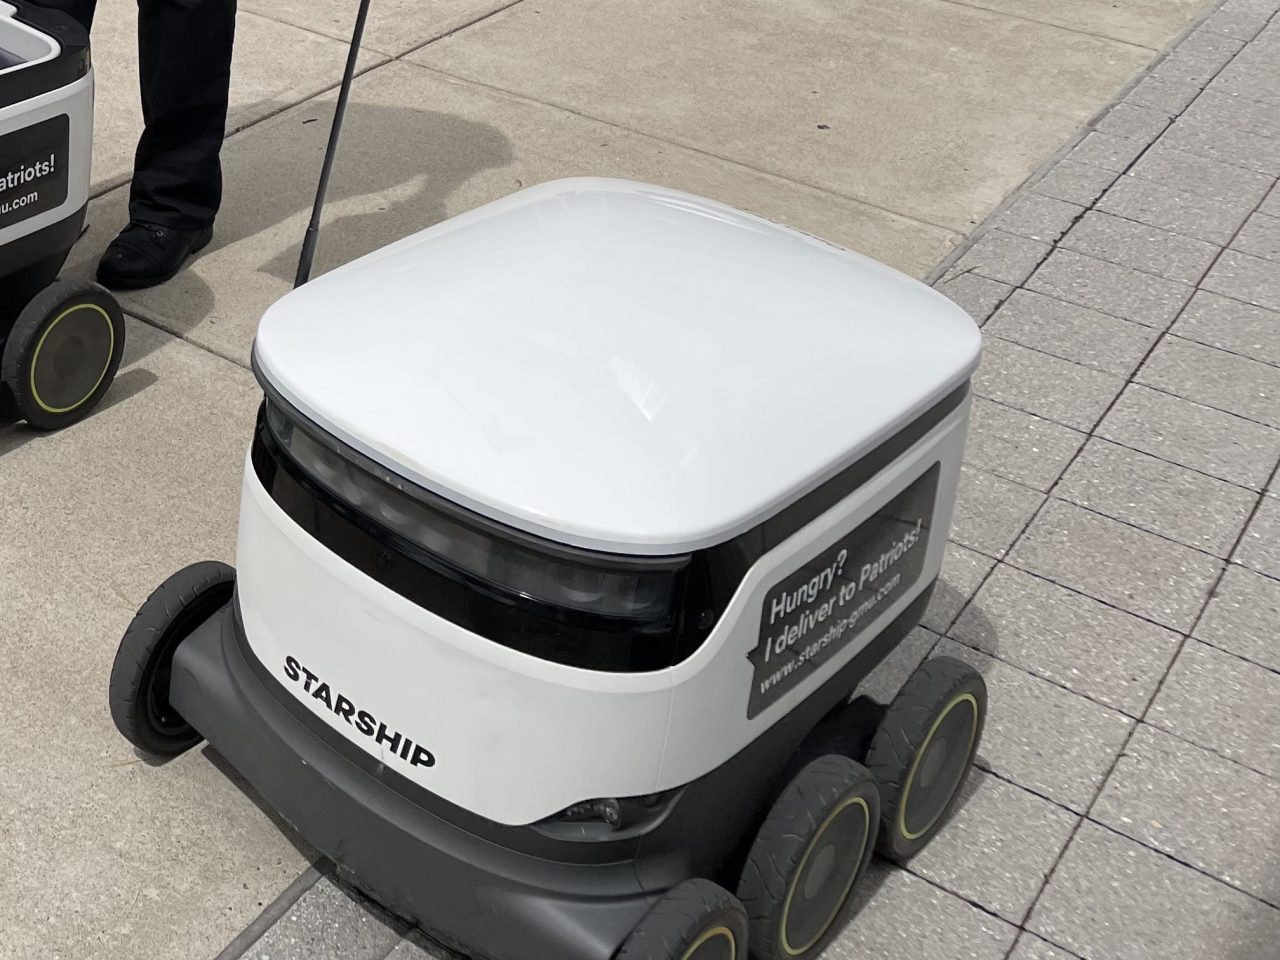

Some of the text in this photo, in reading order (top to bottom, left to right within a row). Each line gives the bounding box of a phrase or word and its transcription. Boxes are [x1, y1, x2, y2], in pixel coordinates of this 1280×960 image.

[761, 573, 901, 694] www.starship-gmu.com
[765, 518, 922, 662] I deliver to Patriots!
[770, 549, 848, 625] Hungry?
[284, 655, 436, 768] STARSHIP
